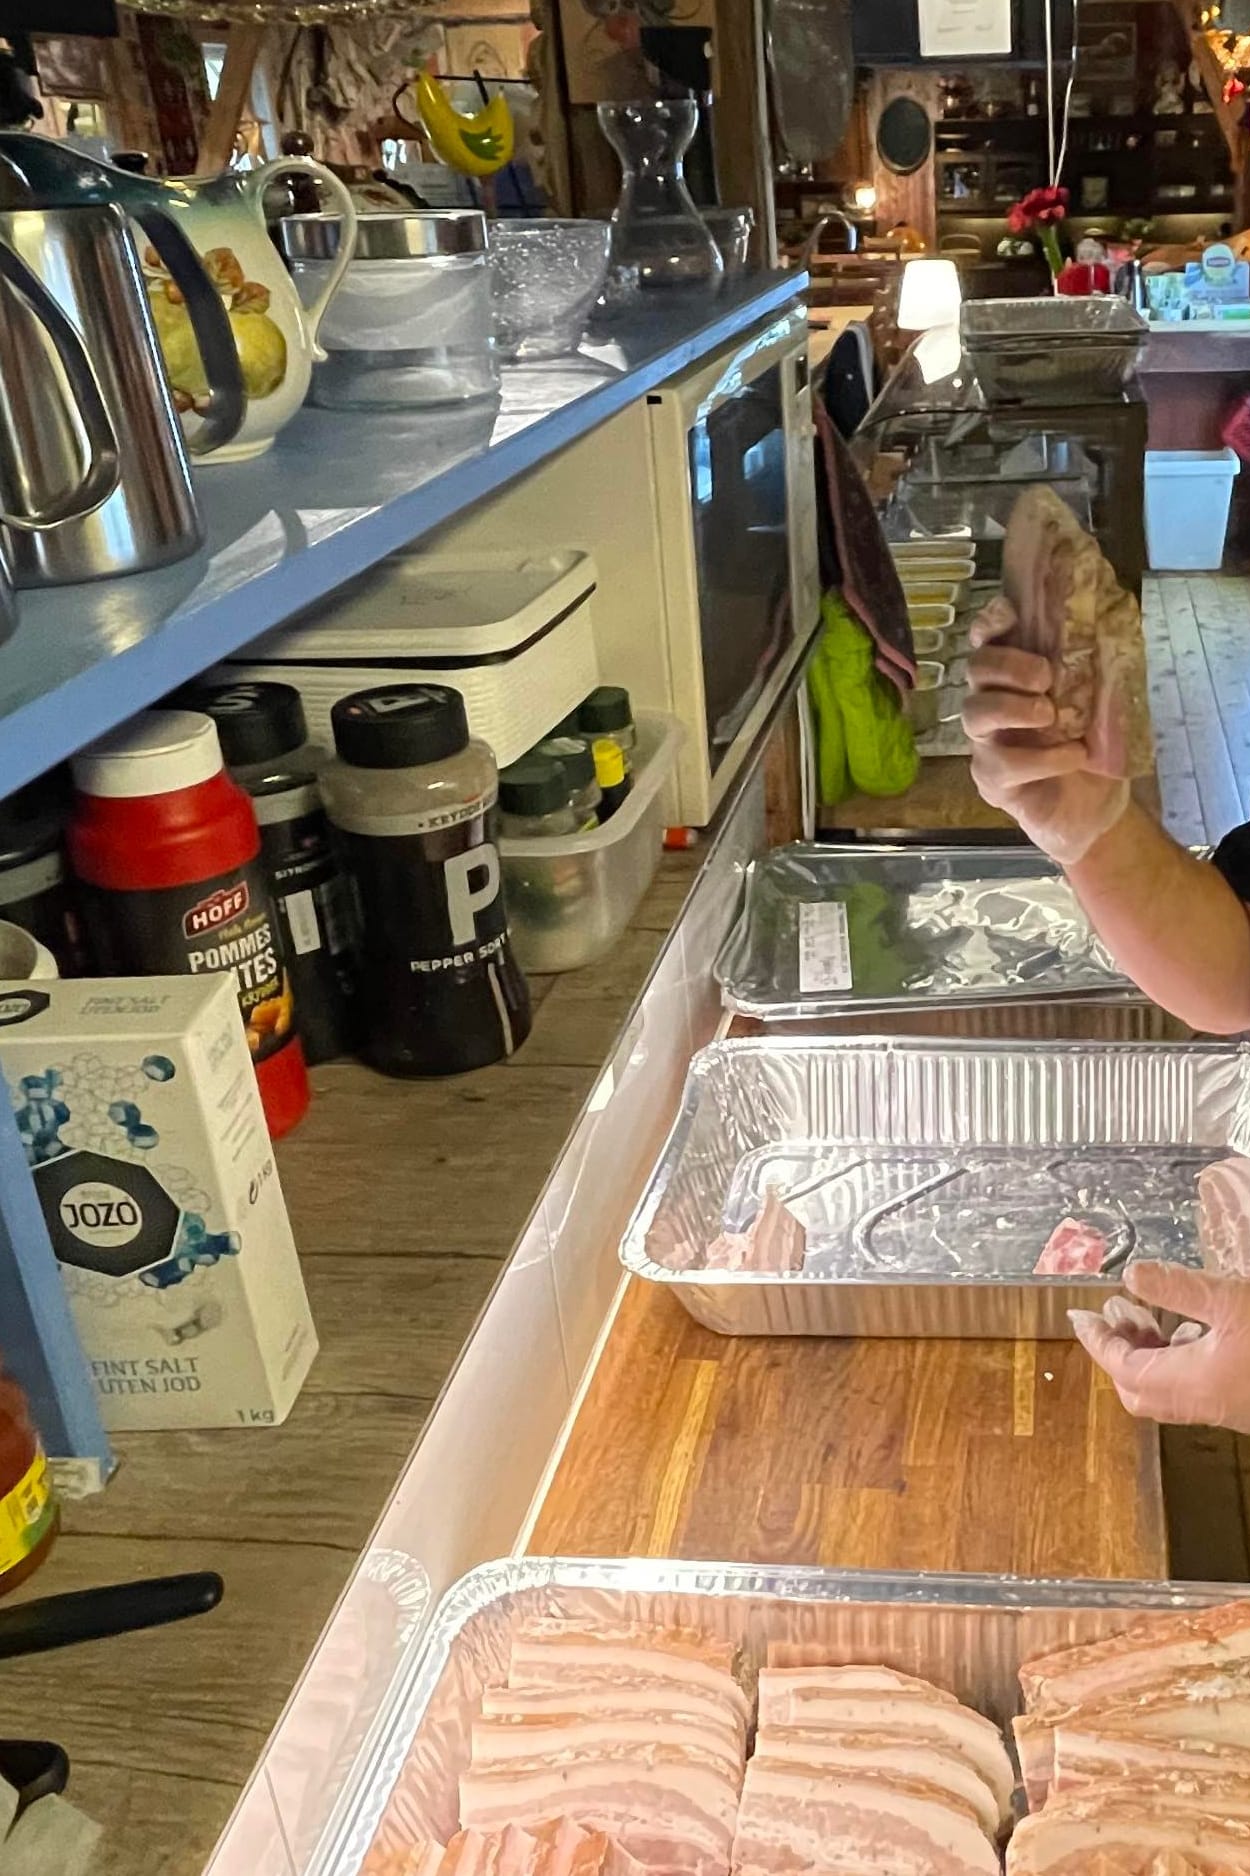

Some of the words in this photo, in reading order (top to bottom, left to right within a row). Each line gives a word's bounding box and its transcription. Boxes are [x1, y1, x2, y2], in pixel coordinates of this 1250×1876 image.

[444, 843, 499, 945] P
[192, 892, 242, 930] HOFF
[188, 923, 271, 973] POMMES
[410, 952, 474, 972] PEPPER
[63, 1202, 137, 1228] JOZO
[92, 1360, 138, 1377] FINT
[145, 1357, 199, 1375] SALT
[99, 1378, 156, 1395] UTEN
[163, 1376, 201, 1393] JOD
[250, 1409, 275, 1423] kg
